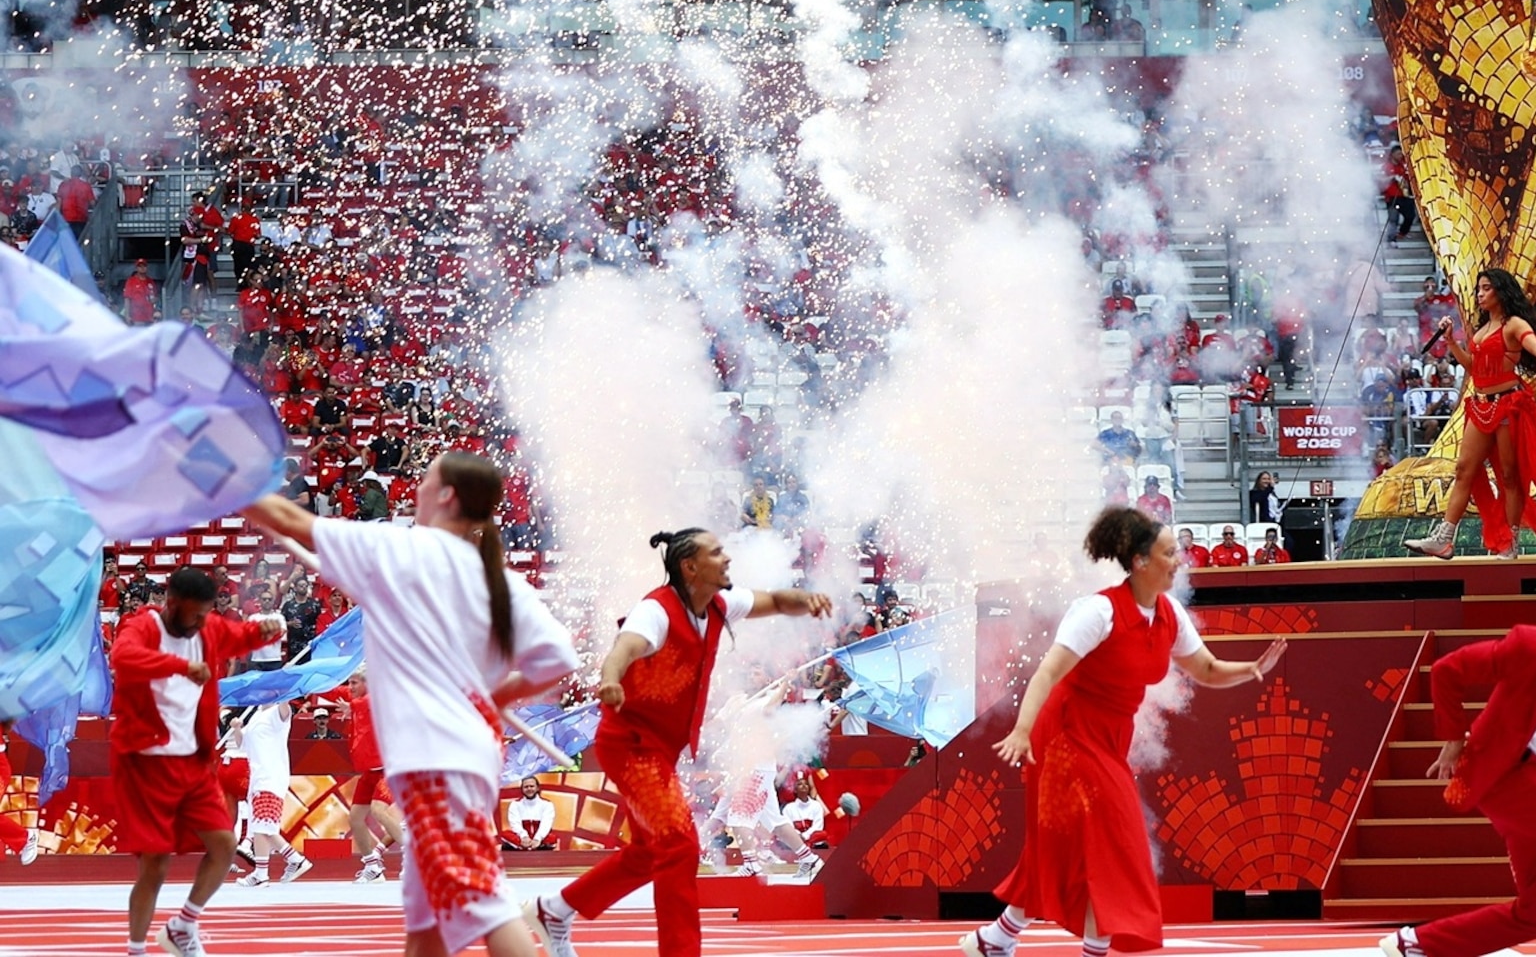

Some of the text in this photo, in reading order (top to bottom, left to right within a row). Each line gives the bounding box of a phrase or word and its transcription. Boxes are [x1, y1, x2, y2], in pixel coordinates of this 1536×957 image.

[1337, 66, 1364, 80] 108
[1306, 415, 1333, 426] FIFA
[1283, 426, 1357, 437] WORLD CUP
[1296, 438, 1342, 449] 2026
